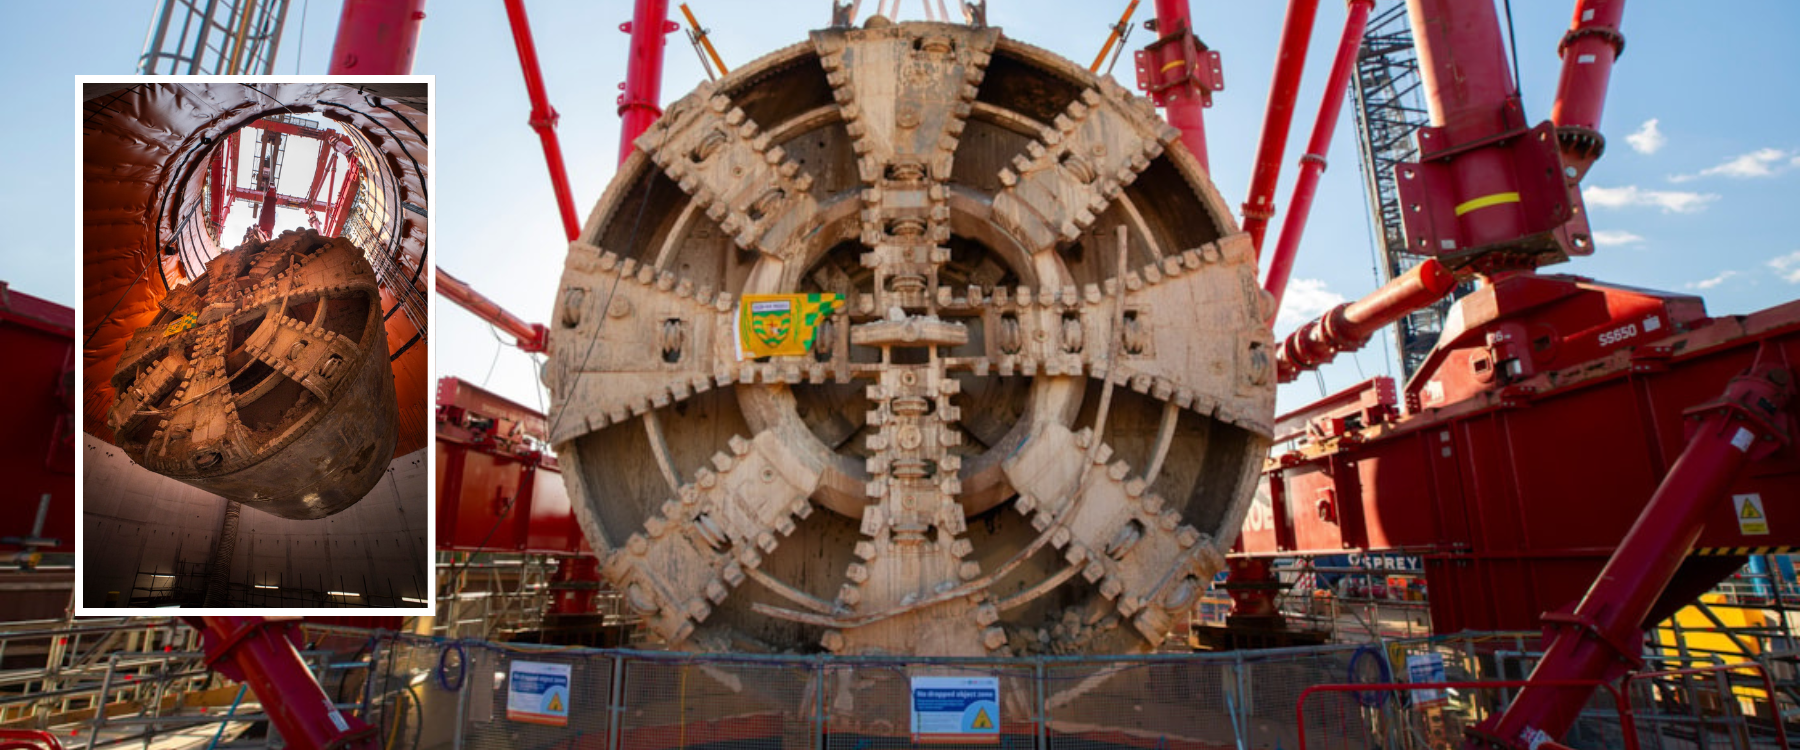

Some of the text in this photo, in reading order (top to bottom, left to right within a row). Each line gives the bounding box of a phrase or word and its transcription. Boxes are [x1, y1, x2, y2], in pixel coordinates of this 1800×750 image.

[1598, 324, 1637, 346] SS650
[1348, 553, 1417, 570] OSPREY
[927, 691, 956, 699] dropped
[956, 691, 976, 699] object
